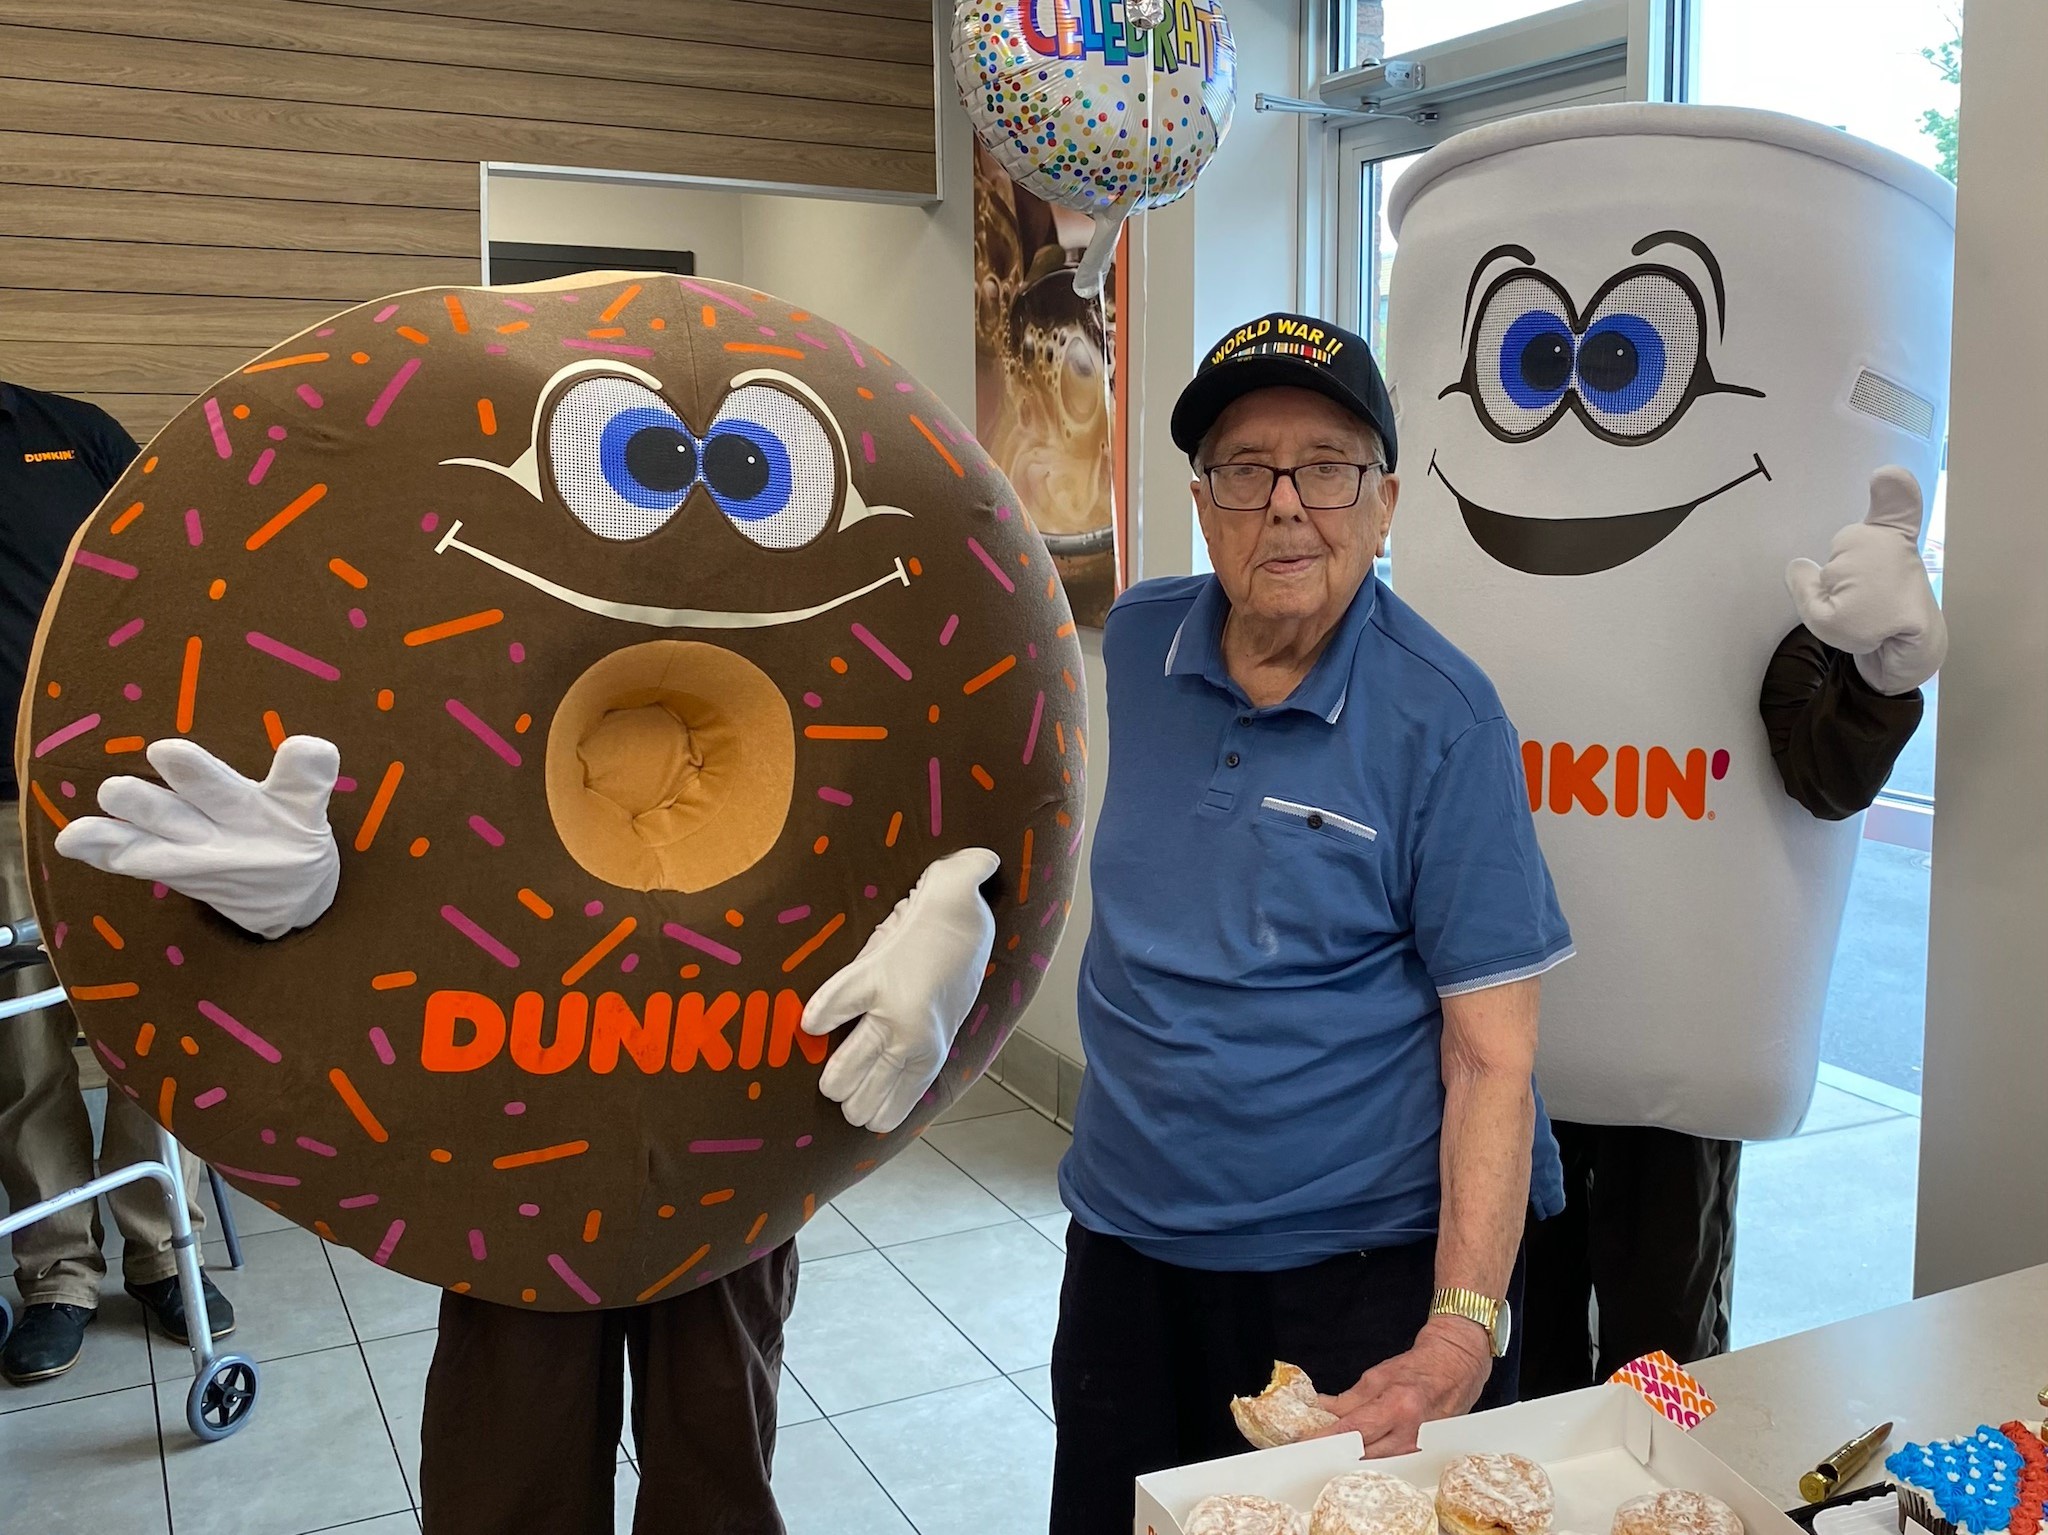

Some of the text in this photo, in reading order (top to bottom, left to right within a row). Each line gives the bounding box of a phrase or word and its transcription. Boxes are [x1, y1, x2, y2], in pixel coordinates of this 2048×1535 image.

[1211, 318, 1344, 366] WORLD WAR II
[1521, 740, 1730, 820] KIN'
